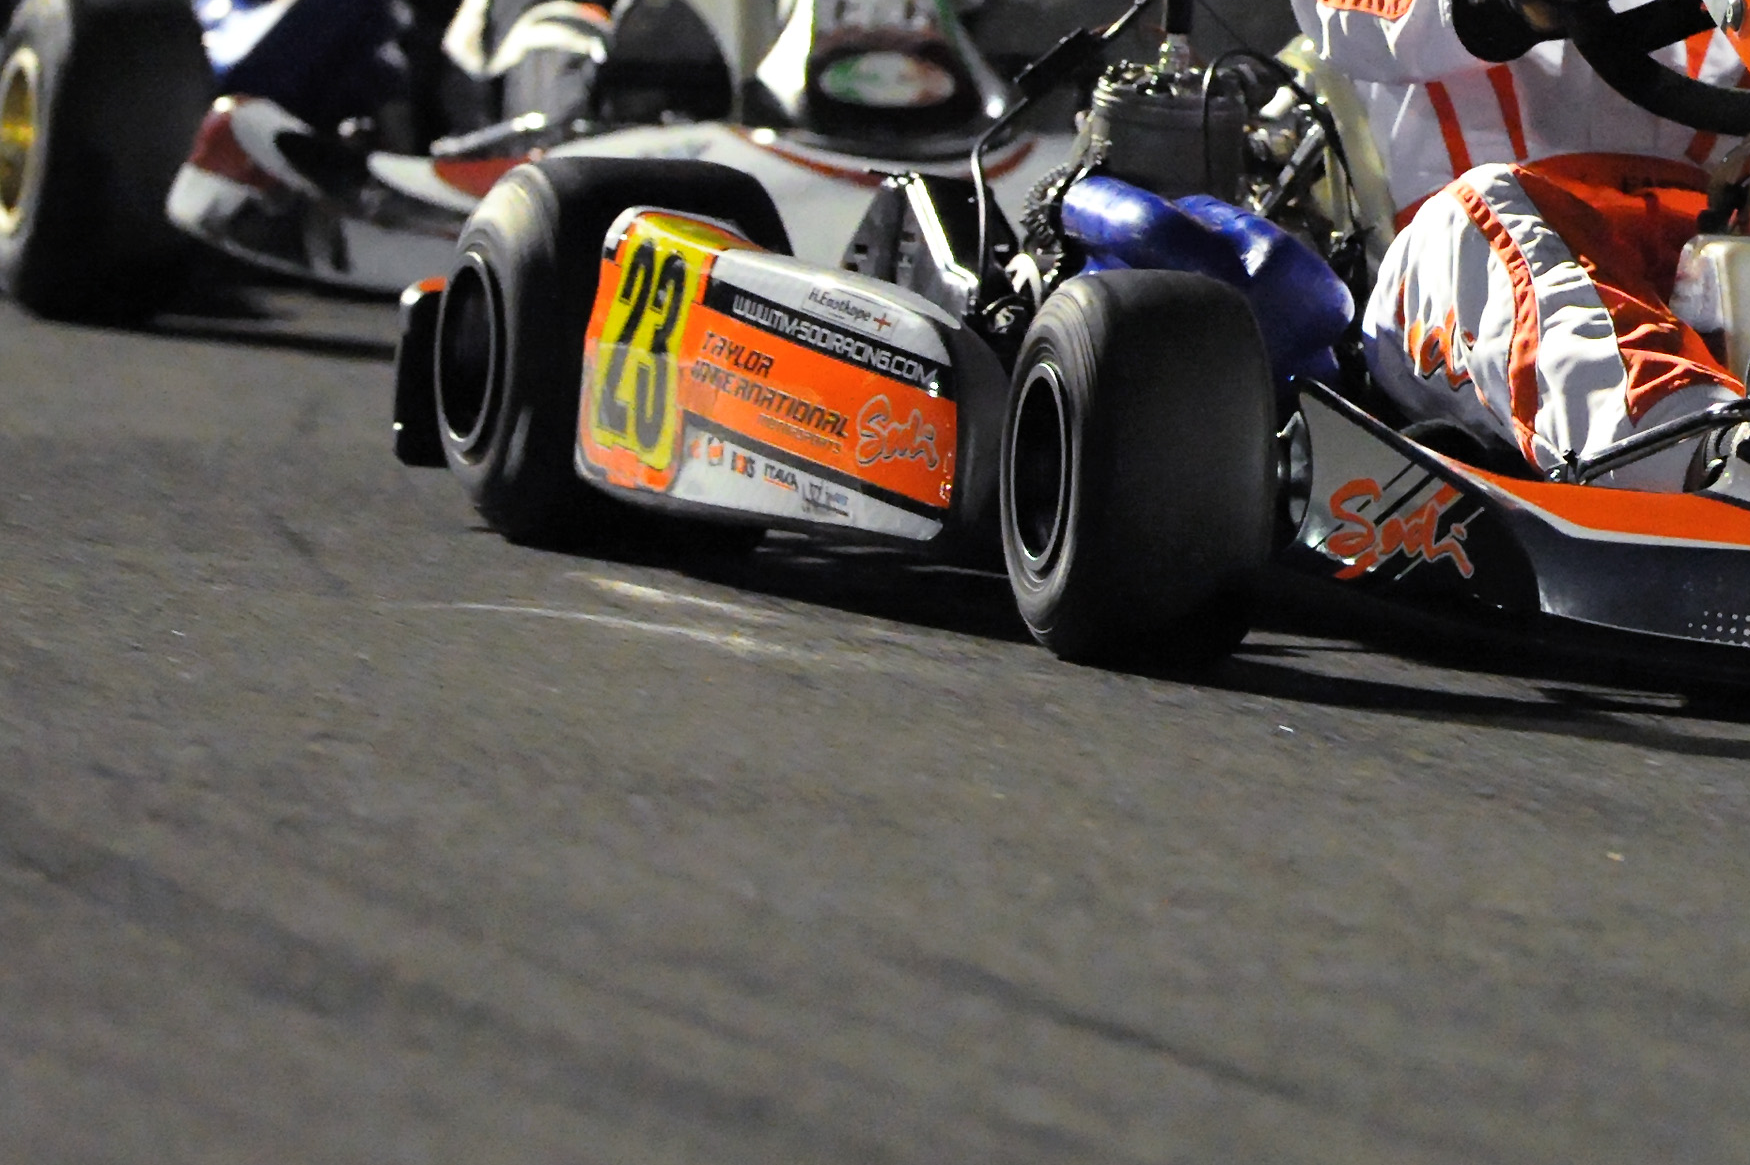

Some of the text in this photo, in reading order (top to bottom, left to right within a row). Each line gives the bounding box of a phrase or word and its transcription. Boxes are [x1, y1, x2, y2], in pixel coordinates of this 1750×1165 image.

[600, 237, 687, 450] 23
[701, 330, 775, 379] TAYLOR
[690, 357, 849, 440] INTERNATIONAL
[1325, 476, 1475, 581] Sodi
